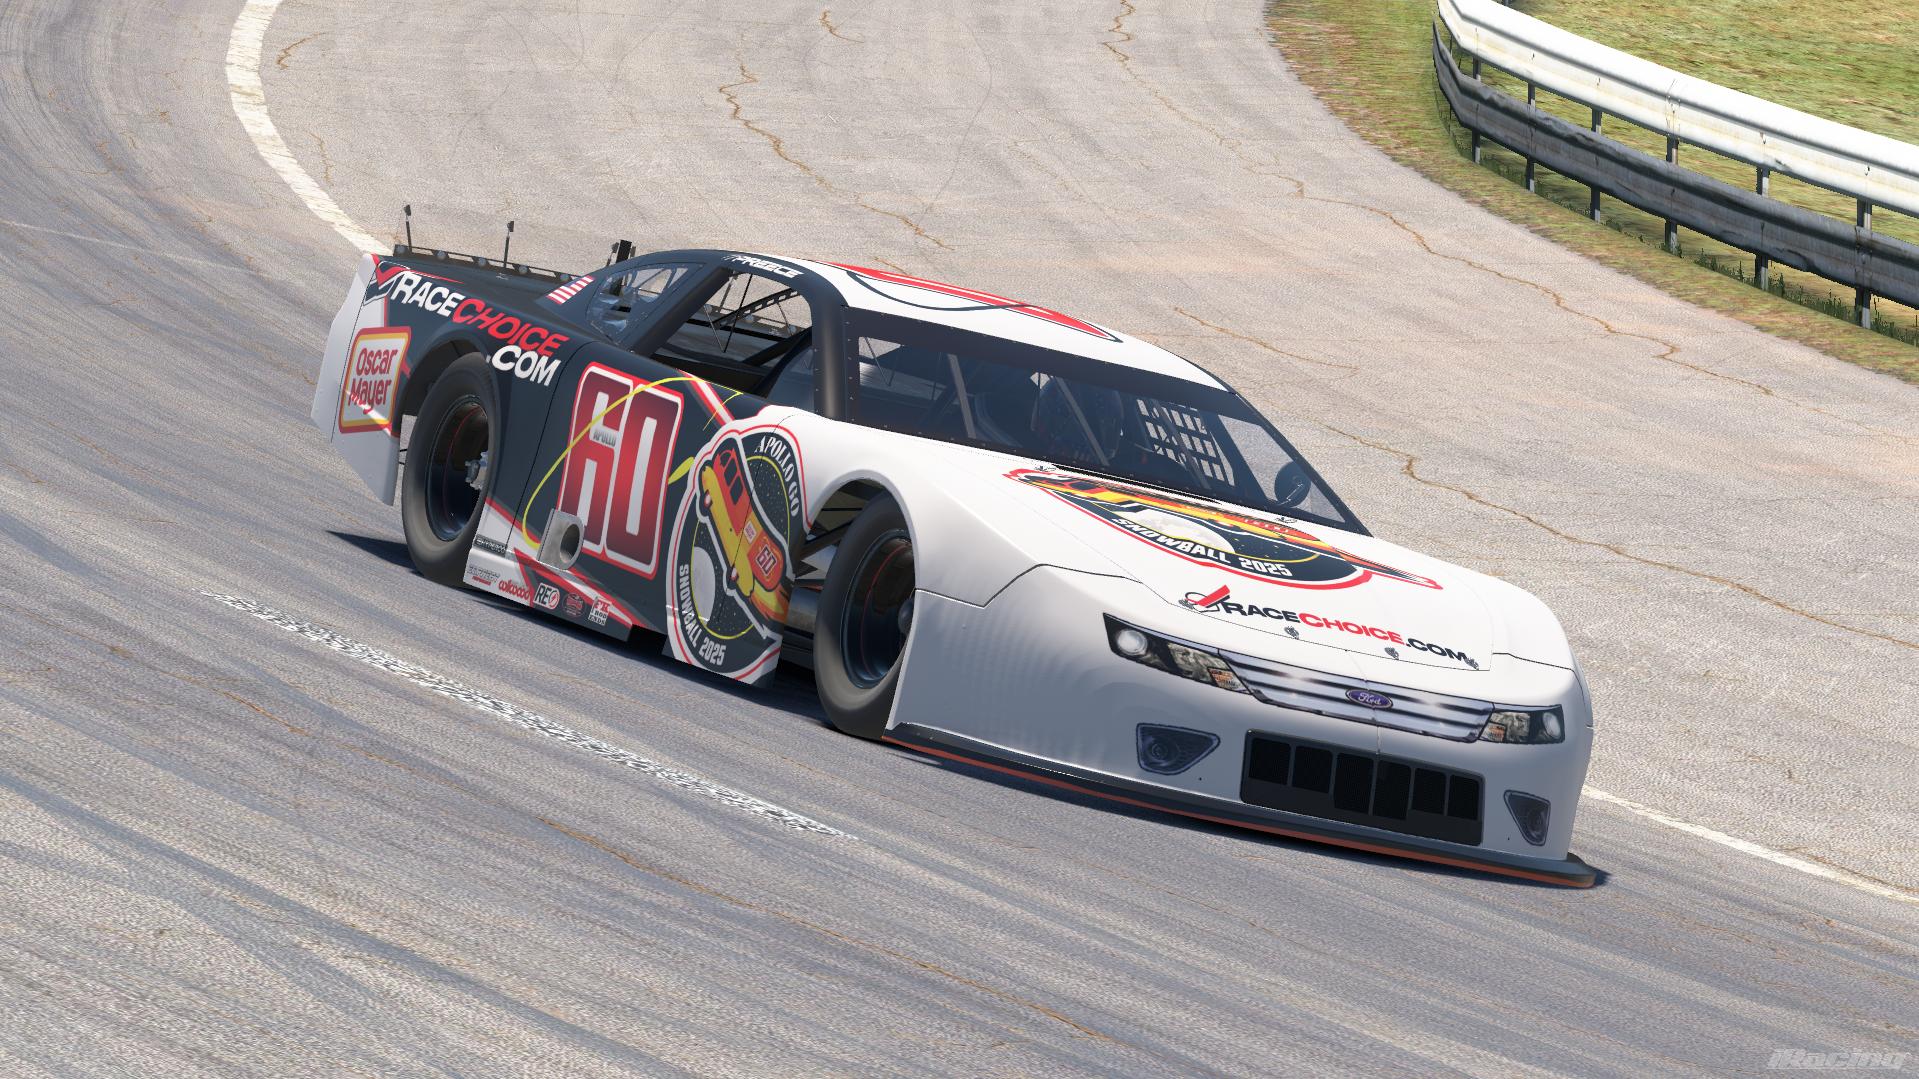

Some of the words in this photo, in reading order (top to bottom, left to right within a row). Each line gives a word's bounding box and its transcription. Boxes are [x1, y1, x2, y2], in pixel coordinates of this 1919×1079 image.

[356, 347, 398, 376] Oscar
[486, 345, 561, 386] .COM
[348, 378, 392, 414] Mayer
[557, 362, 684, 580] 60
[754, 436, 794, 482] APOLLO
[756, 545, 776, 576] 60
[1111, 517, 1231, 564] SNOWBALL
[1239, 557, 1293, 577] 2025
[680, 564, 702, 648] SNOWBALL
[699, 637, 727, 666] 2025
[1358, 692, 1381, 705] Ford
